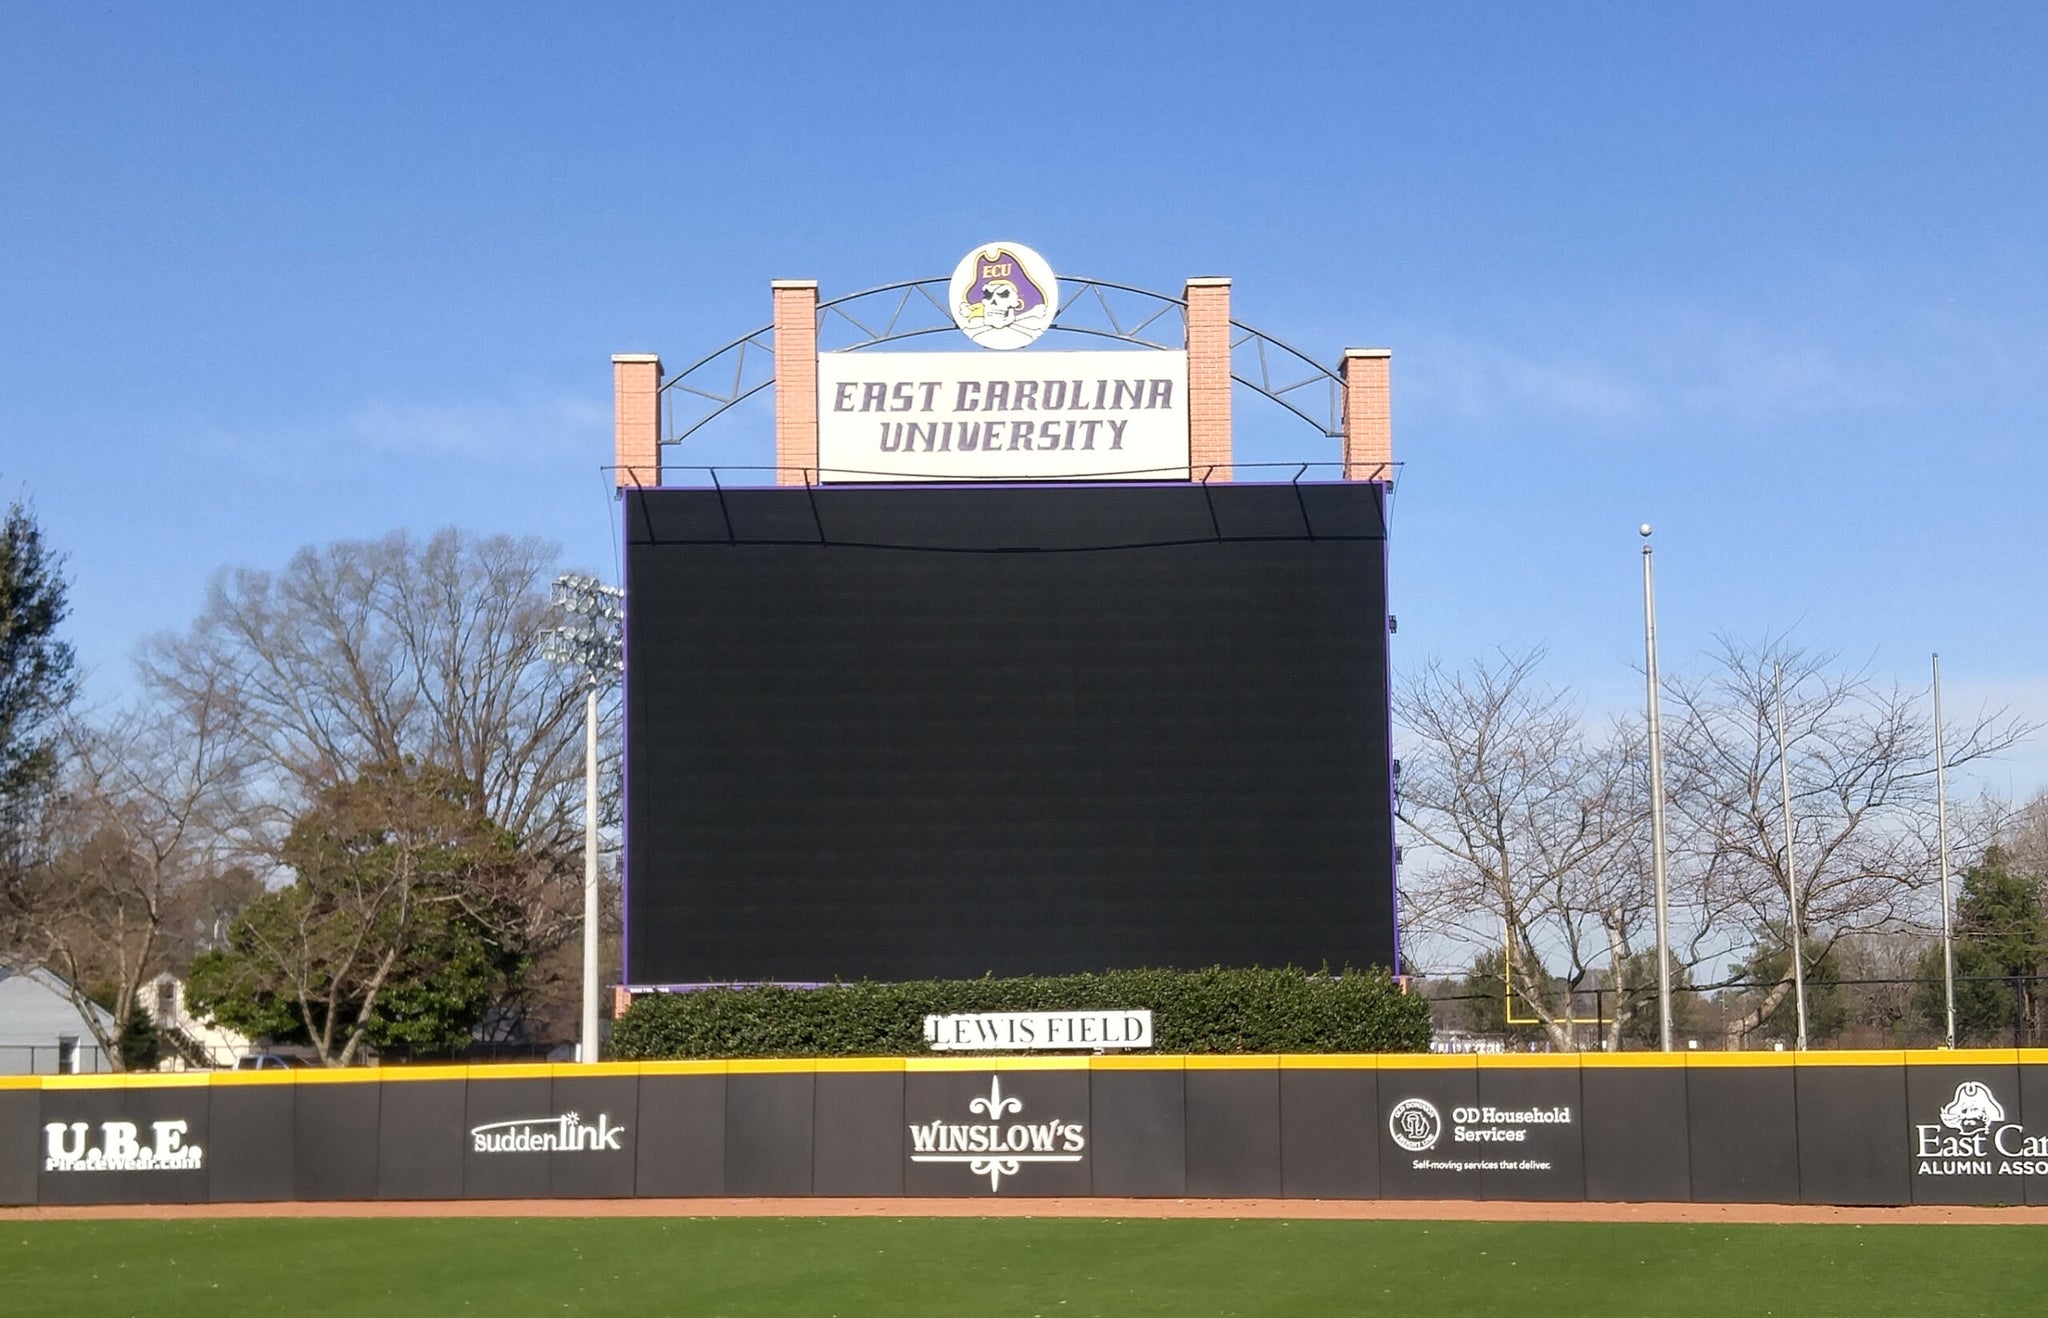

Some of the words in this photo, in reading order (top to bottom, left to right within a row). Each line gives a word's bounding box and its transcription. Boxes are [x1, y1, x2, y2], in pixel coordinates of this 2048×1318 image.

[982, 263, 1012, 279] ECU
[833, 381, 943, 412] EAST
[952, 378, 1174, 413] CAROLINA
[880, 419, 1129, 452] UNIVERSITY
[932, 1018, 1036, 1044] LEWIS
[1047, 1016, 1144, 1043] FIELD
[1452, 1107, 1480, 1124] OD
[1482, 1106, 1571, 1124] Household
[44, 1120, 203, 1161] U.B.E.
[474, 1112, 622, 1152] suddenlink
[908, 1118, 1086, 1152] WINSLOW'S
[1454, 1127, 1526, 1142] Services
[1915, 1124, 1988, 1158] East
[1412, 1160, 1462, 1172] Self-moving
[1463, 1160, 1499, 1170] services
[1499, 1160, 1518, 1170] that
[1518, 1160, 1551, 1170] deliver.
[1917, 1160, 1992, 1175] ALUMNI
